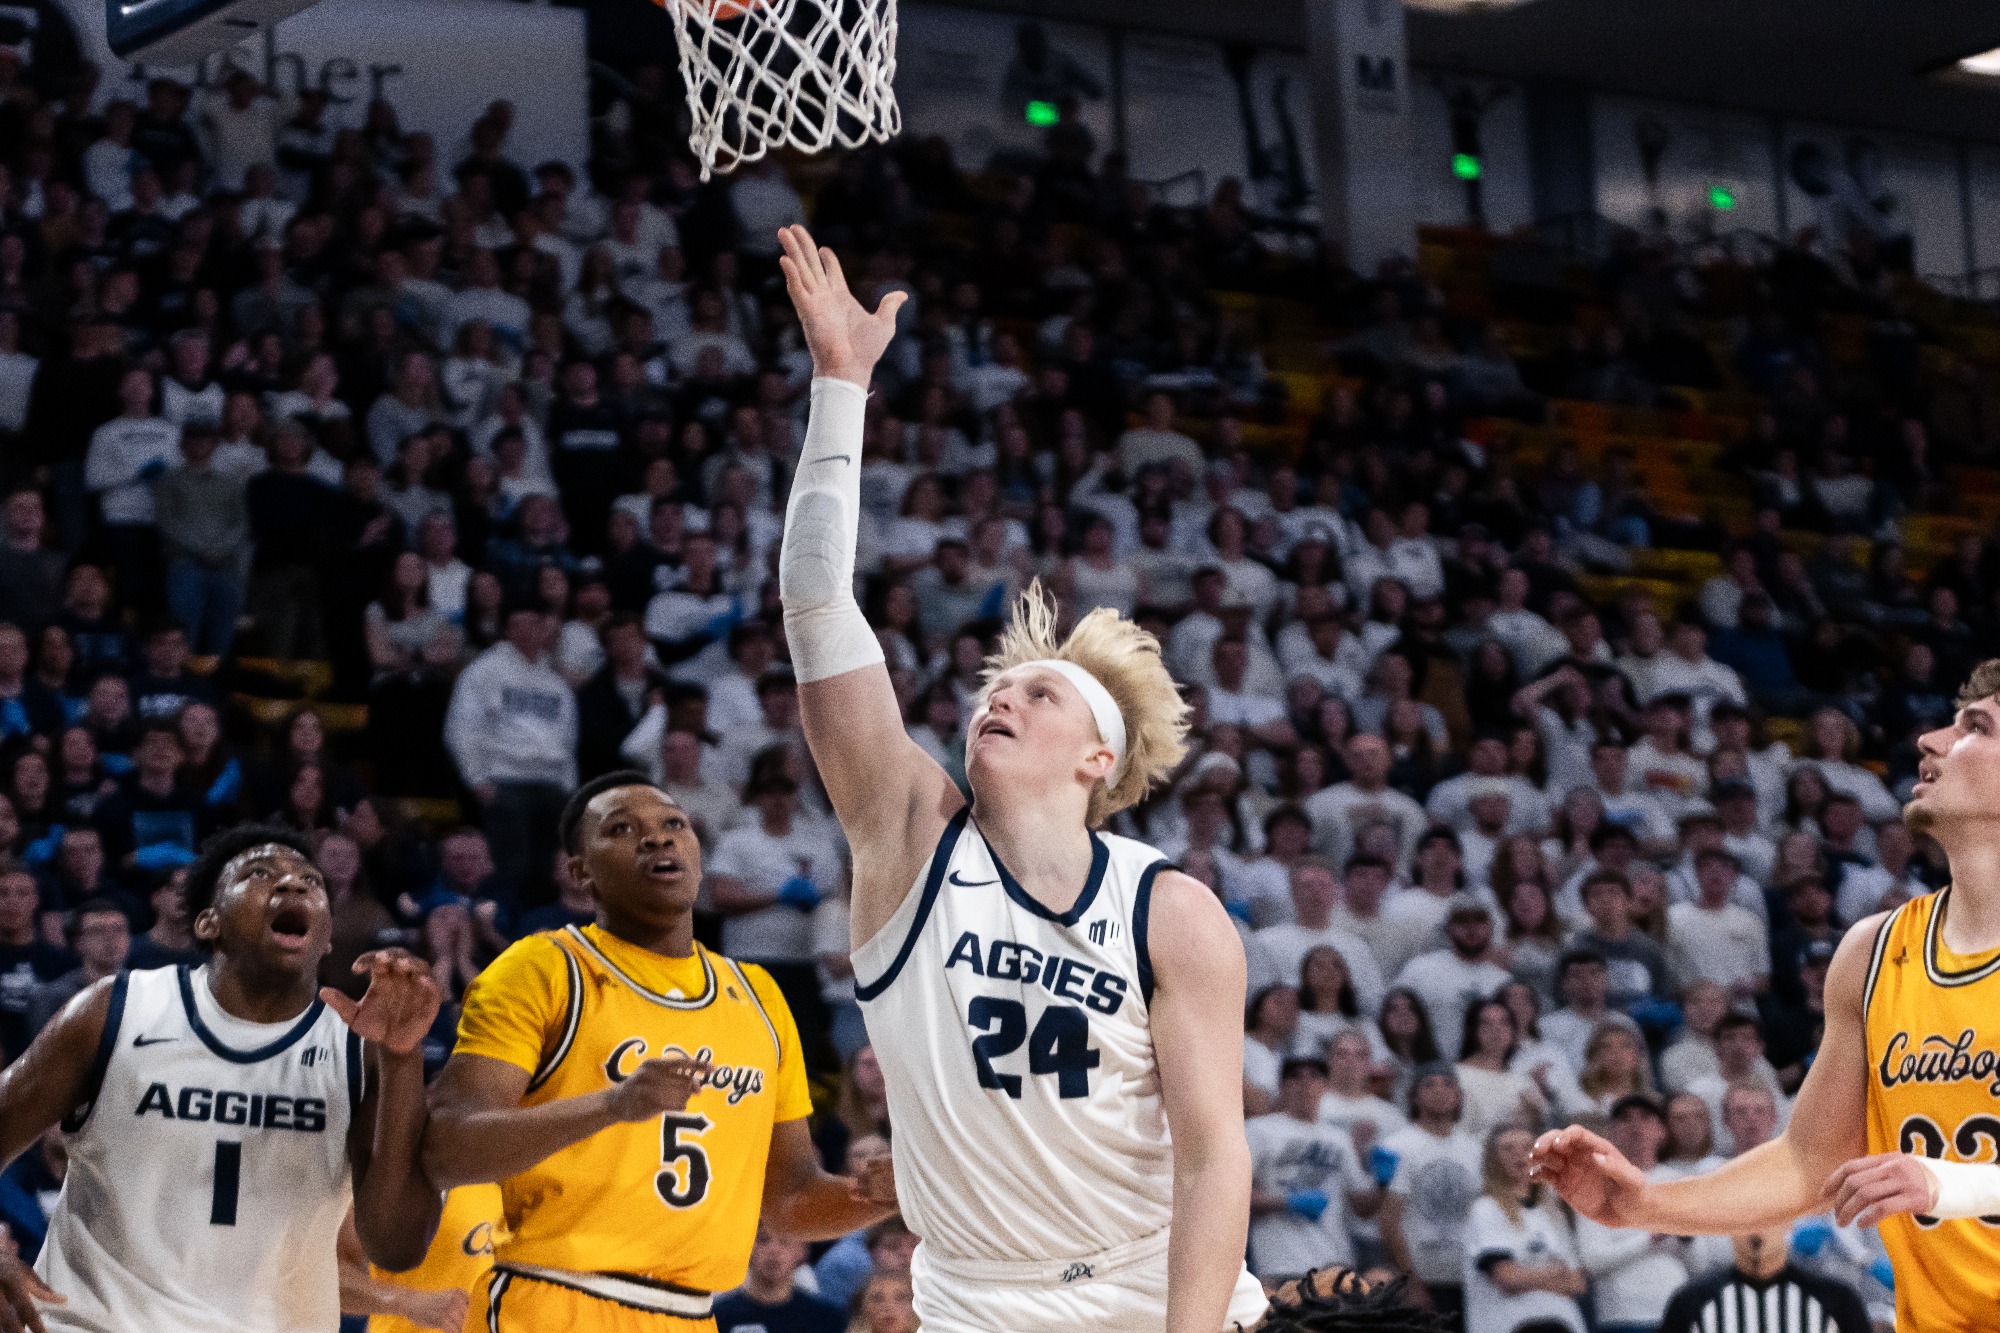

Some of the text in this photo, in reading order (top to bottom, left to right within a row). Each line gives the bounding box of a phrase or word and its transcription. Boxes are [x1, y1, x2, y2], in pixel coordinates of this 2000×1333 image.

[945, 930, 1128, 1016] AGGIES
[604, 1037, 764, 1106] Cboys
[967, 995, 1101, 1100] 24
[134, 1082, 327, 1133] AGGIES
[209, 1140, 243, 1227] 1
[654, 1111, 715, 1211] 5
